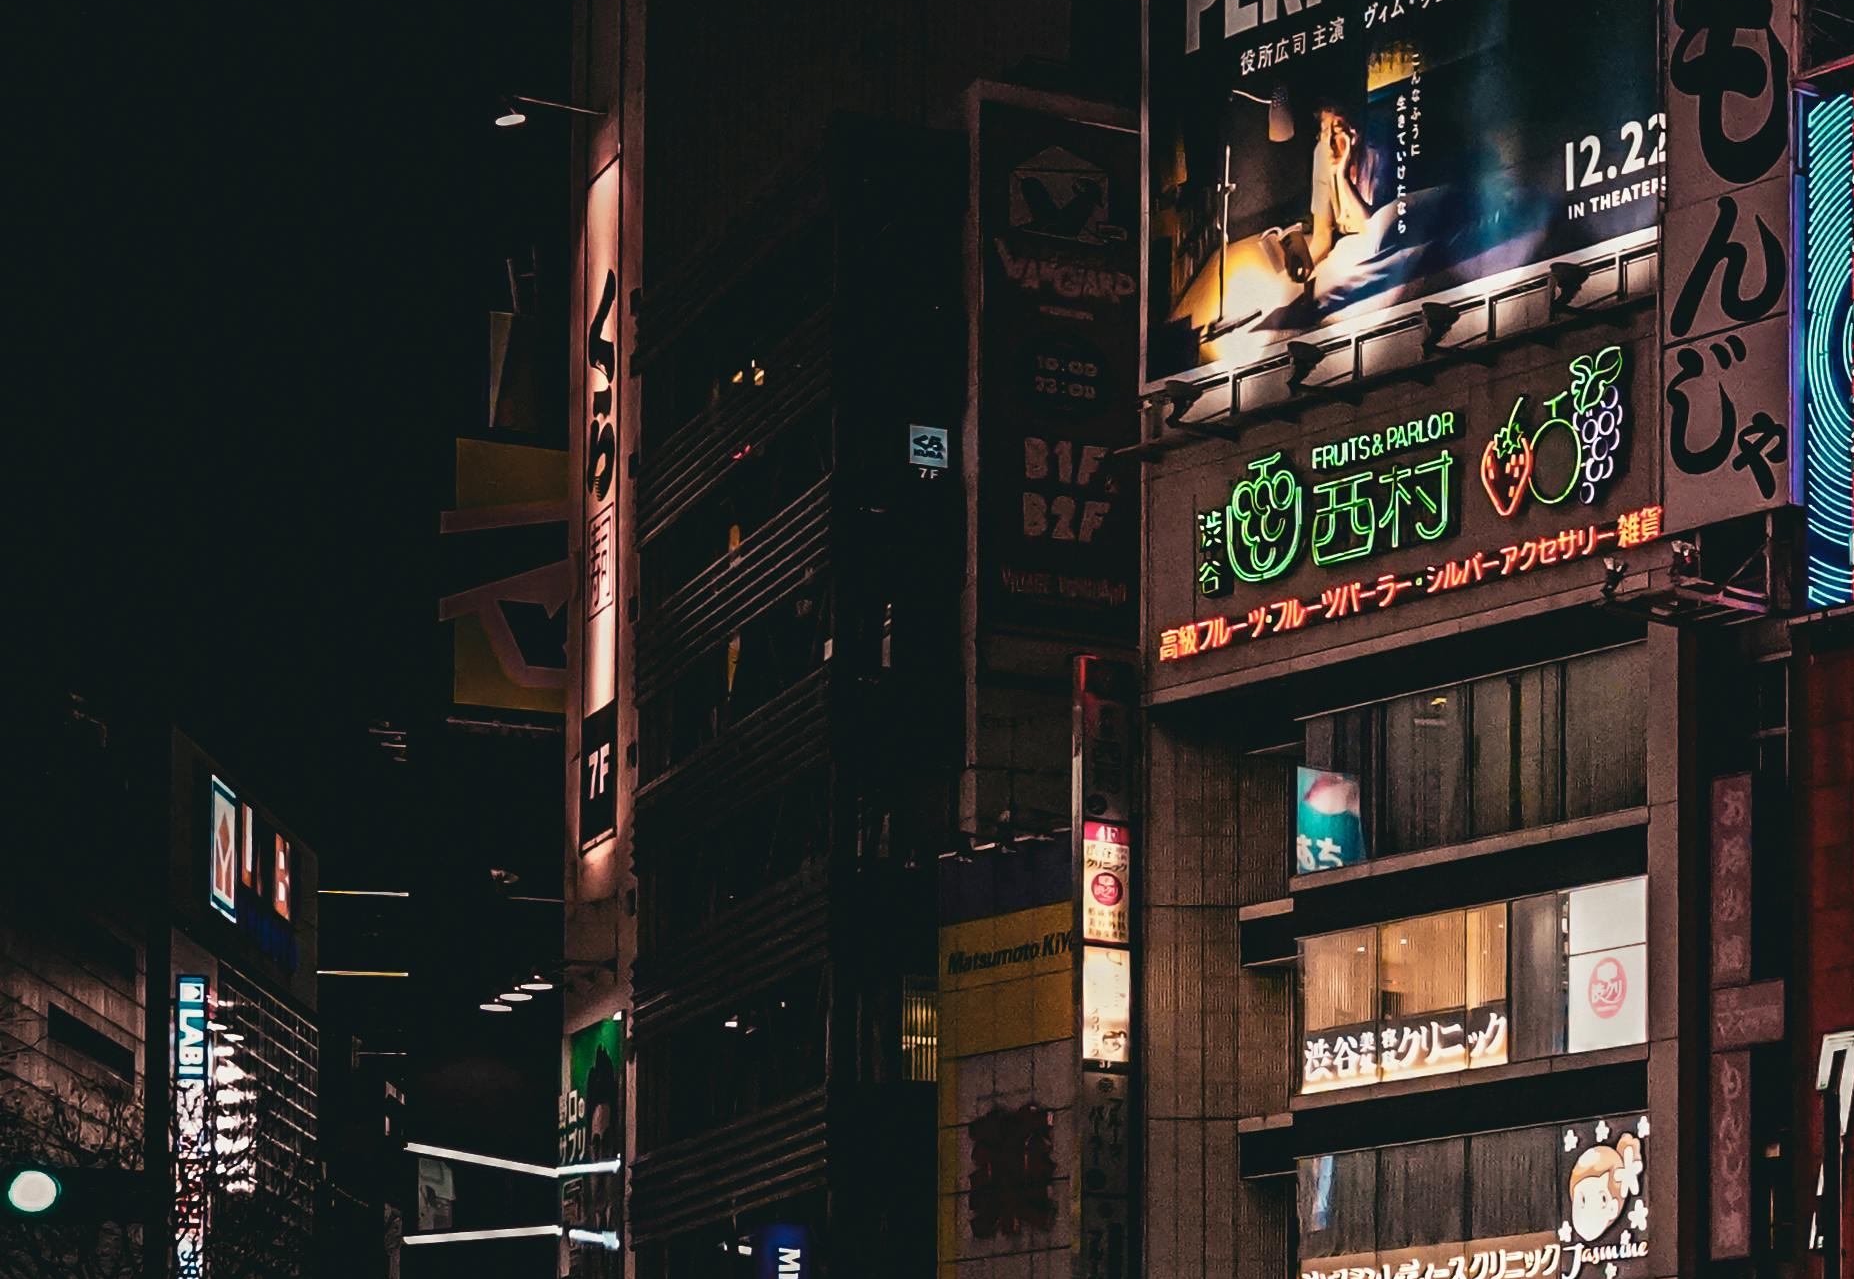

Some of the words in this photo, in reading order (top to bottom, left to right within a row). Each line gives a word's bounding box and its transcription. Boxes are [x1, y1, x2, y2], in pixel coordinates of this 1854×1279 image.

[1568, 202, 1585, 220] IN
[1311, 449, 1454, 567] 西村
[947, 936, 1041, 974] Matsumoto
[179, 1012, 206, 1080] LABI
